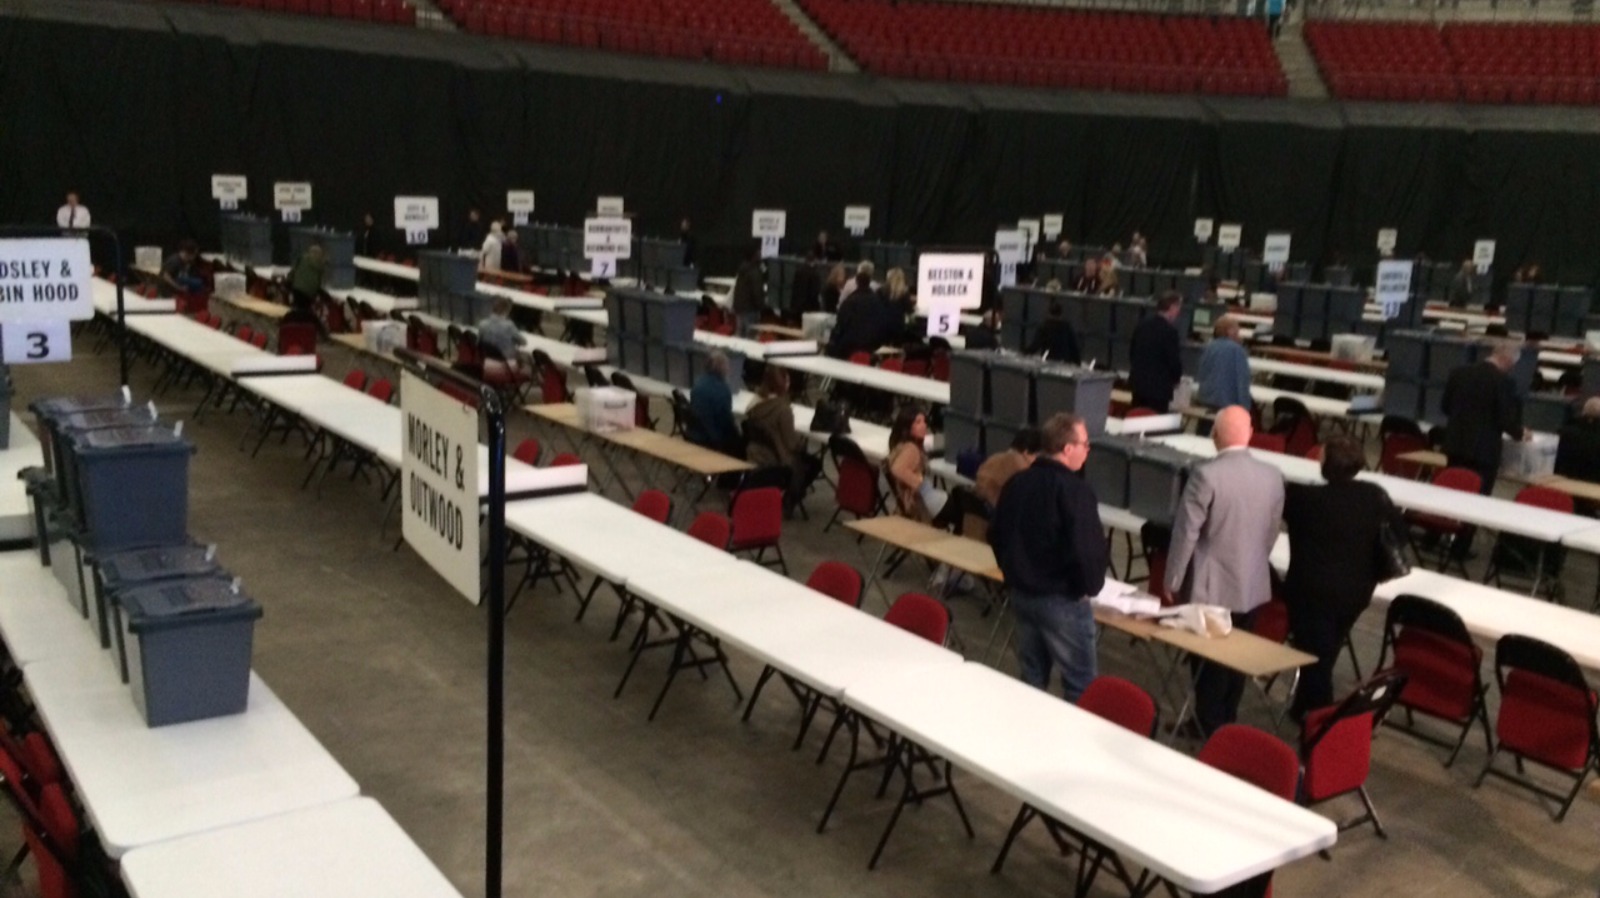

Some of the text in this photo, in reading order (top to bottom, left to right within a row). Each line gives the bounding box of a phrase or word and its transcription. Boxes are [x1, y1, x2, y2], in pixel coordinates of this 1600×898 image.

[60, 259, 72, 277] &
[928, 268, 964, 281] BEESTON
[33, 283, 79, 303] HOOD
[931, 284, 968, 296] HOLBECK
[939, 315, 950, 333] 5
[26, 332, 50, 359] 3
[408, 411, 466, 492] MORLEY &
[410, 471, 464, 552] OUTWOOD
